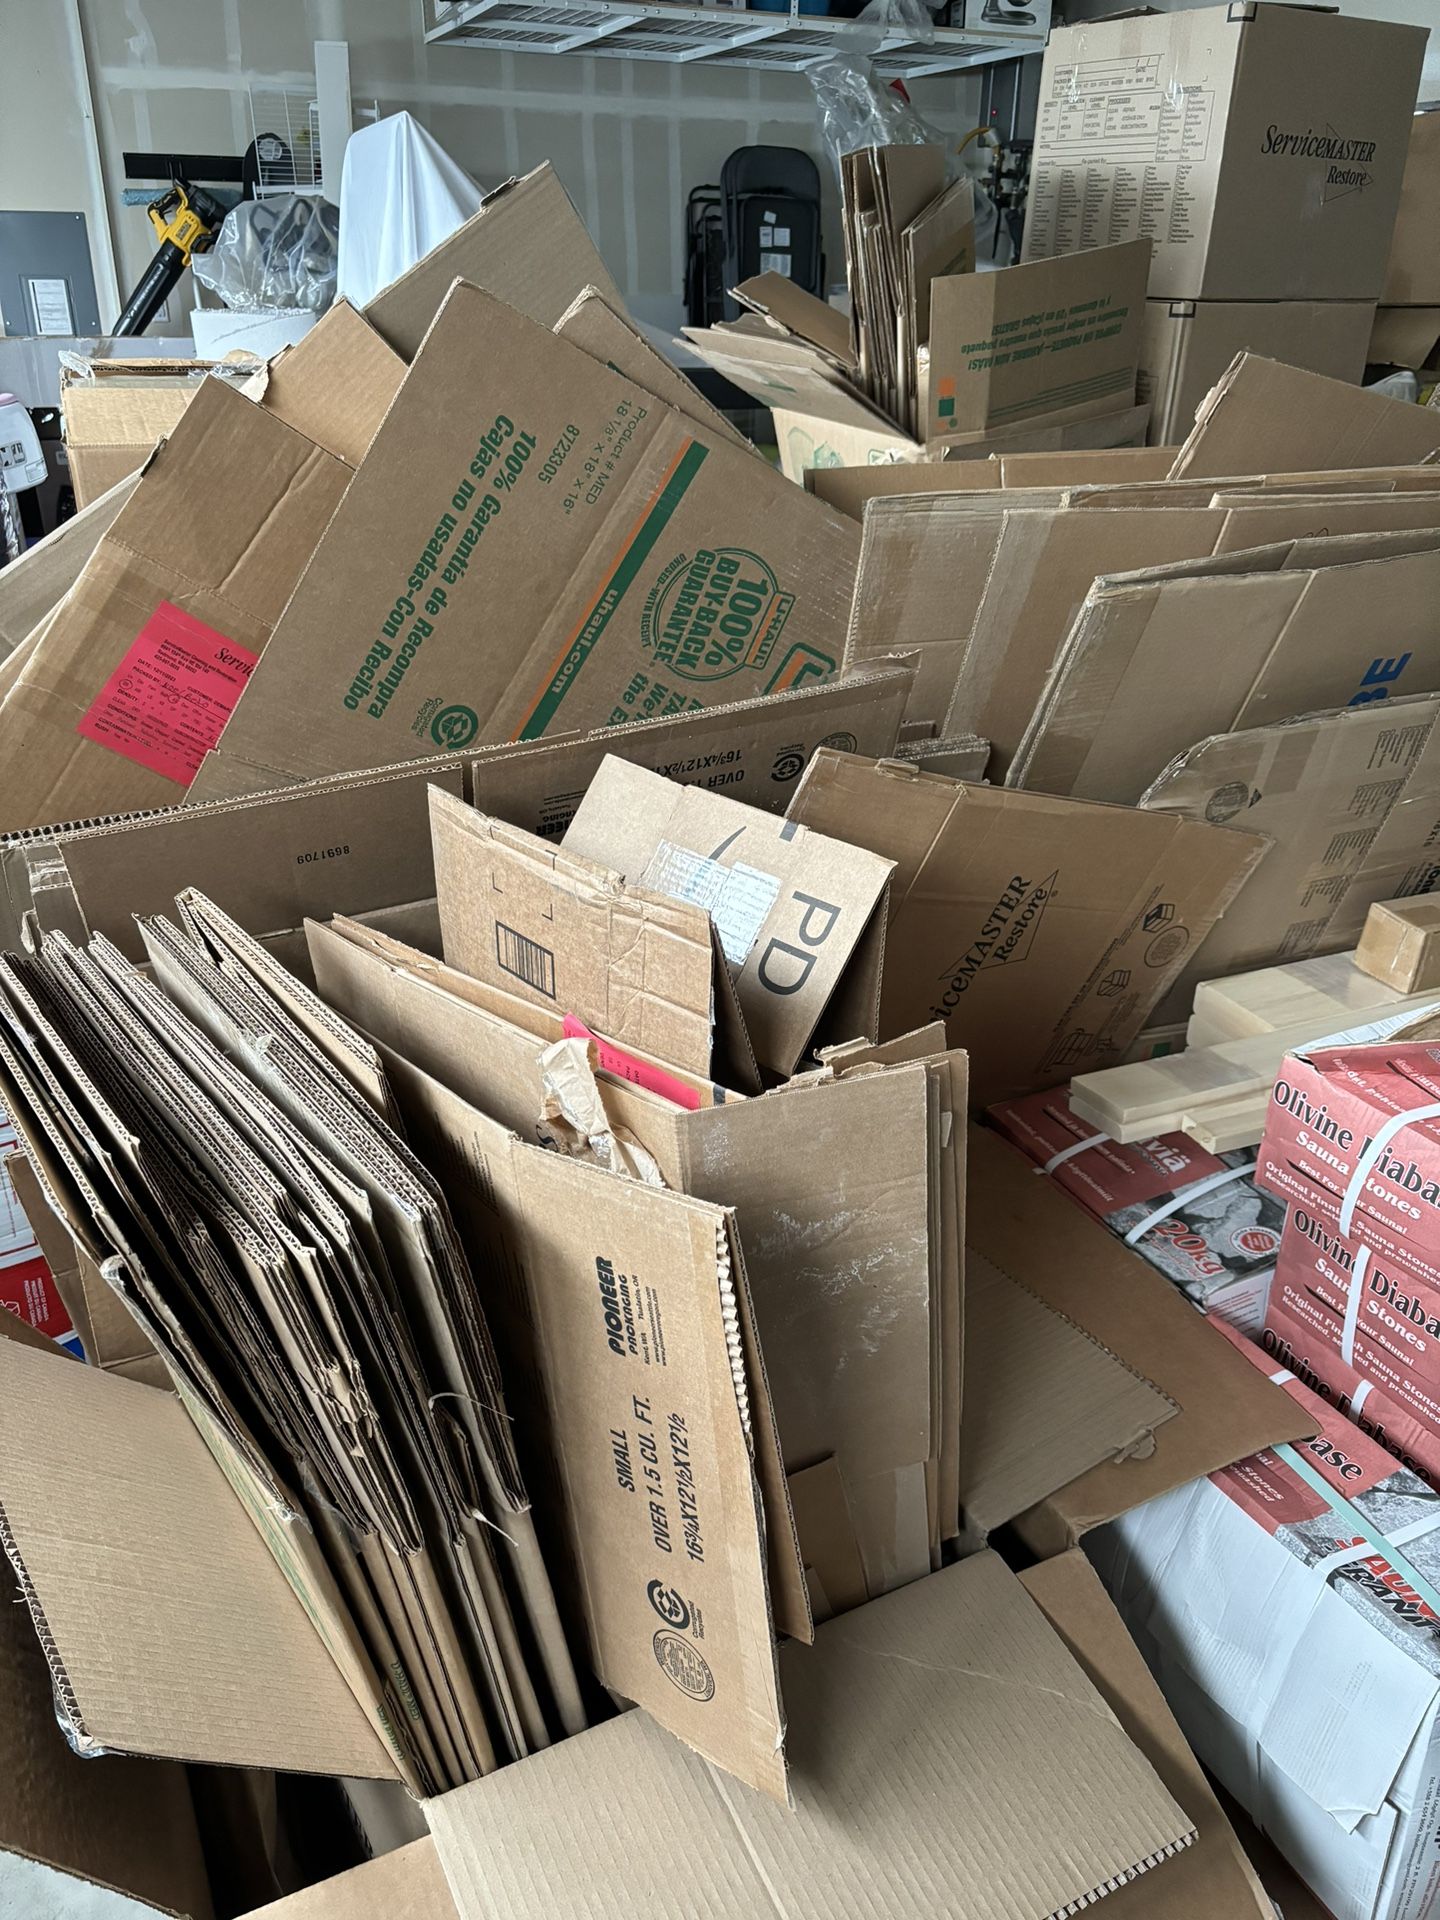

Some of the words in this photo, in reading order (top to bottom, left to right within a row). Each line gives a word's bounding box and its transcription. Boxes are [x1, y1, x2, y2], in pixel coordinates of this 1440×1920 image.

[1261, 124, 1377, 162] ServiceMASTER
[1327, 165, 1367, 186] Restore
[609, 404, 648, 461] Product
[615, 397, 633, 417] 18
[464, 411, 518, 482] Cajas
[490, 428, 540, 494] 100%
[536, 422, 581, 486] 8723305
[603, 460, 614, 471] #
[449, 478, 479, 513] no
[583, 471, 609, 506] MED
[439, 492, 503, 588] Garantía
[379, 511, 461, 641] usadas-Con
[422, 585, 452, 618] de
[652, 548, 717, 664] GUARANTEE
[550, 587, 621, 694] uhaul.com
[674, 555, 740, 669] BUY-BACK
[703, 578, 771, 664] 100%
[752, 597, 790, 665] U-HAUL
[340, 638, 394, 714] Recibo
[362, 614, 435, 722] Recompra
[620, 671, 650, 707] the
[296, 845, 349, 864] 8691709
[750, 886, 841, 1003] PD
[928, 872, 1033, 1021] iceMASTER
[992, 886, 1049, 963] Restore
[1270, 1077, 1356, 1151] Olivine
[1295, 1129, 1351, 1176] Sauna
[1362, 1175, 1422, 1220] tones
[1298, 1159, 1321, 1178] Best
[1321, 1174, 1339, 1191] For
[1366, 1204, 1407, 1235] Sauna!
[1151, 1219, 1226, 1274] 20kg
[1264, 1161, 1309, 1195] Original
[1308, 1191, 1340, 1215] Finni
[1355, 1220, 1395, 1250] Sauna
[1397, 1247, 1440, 1279] Stones
[1290, 1208, 1356, 1273] Olivin
[594, 1253, 625, 1356] PIONEER
[617, 1274, 637, 1354] PACKAGING
[631, 1274, 638, 1286] OR
[1313, 1256, 1354, 1296] Saun
[1365, 1299, 1428, 1352] Stones
[1281, 1295, 1332, 1338] Researched,
[1369, 1364, 1389, 1383] and
[1387, 1381, 1440, 1424] prewashed
[1282, 1284, 1324, 1322] Original
[1364, 1349, 1402, 1383] Sauna
[1402, 1378, 1440, 1414] Stones
[1315, 1286, 1337, 1306] Best
[1354, 1316, 1379, 1339] Your
[1378, 1333, 1414, 1366] Sauna!
[632, 1393, 652, 1427] FT.
[609, 1426, 635, 1494] SMALL
[637, 1430, 658, 1465] CU.
[643, 1463, 663, 1499] 1.5
[1241, 1463, 1285, 1501] stones
[648, 1499, 672, 1554] OVER
